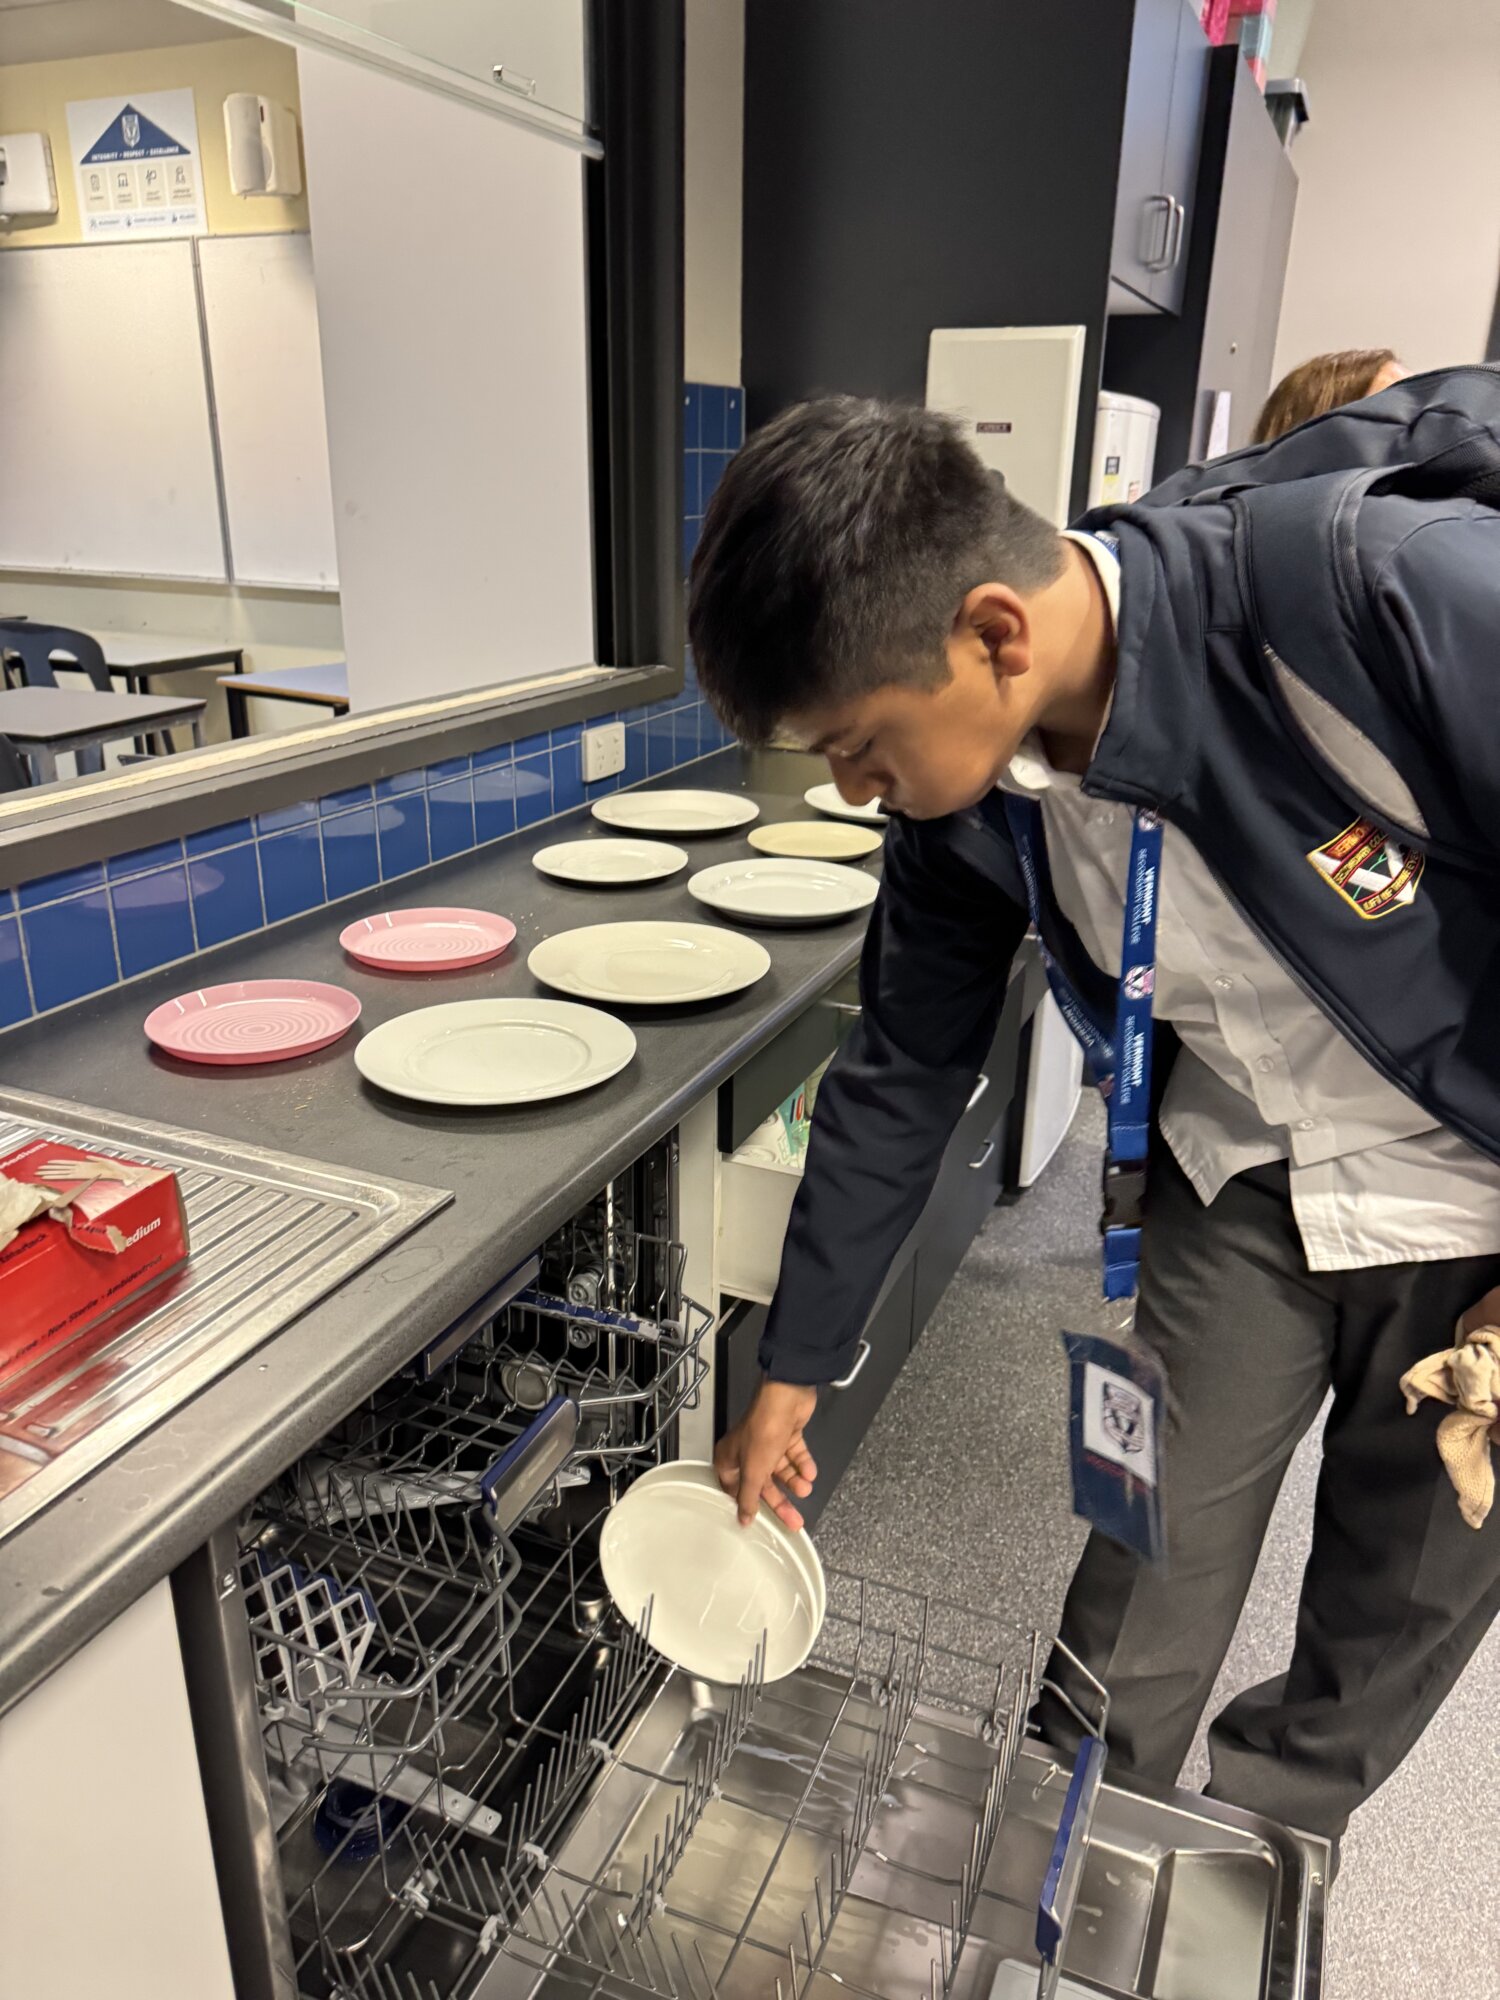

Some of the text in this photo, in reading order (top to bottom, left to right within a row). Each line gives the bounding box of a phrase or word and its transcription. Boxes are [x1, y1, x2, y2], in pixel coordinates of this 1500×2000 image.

[91, 151, 118, 161] INTEGRITY
[122, 149, 145, 159] RESPECT
[1141, 866, 1155, 926] VERMONT
[1060, 1003, 1095, 1048] VERMONT
[1130, 1032, 1145, 1087] VERMONT
[126, 1217, 161, 1247] edium
[68, 1299, 99, 1323] Sterile
